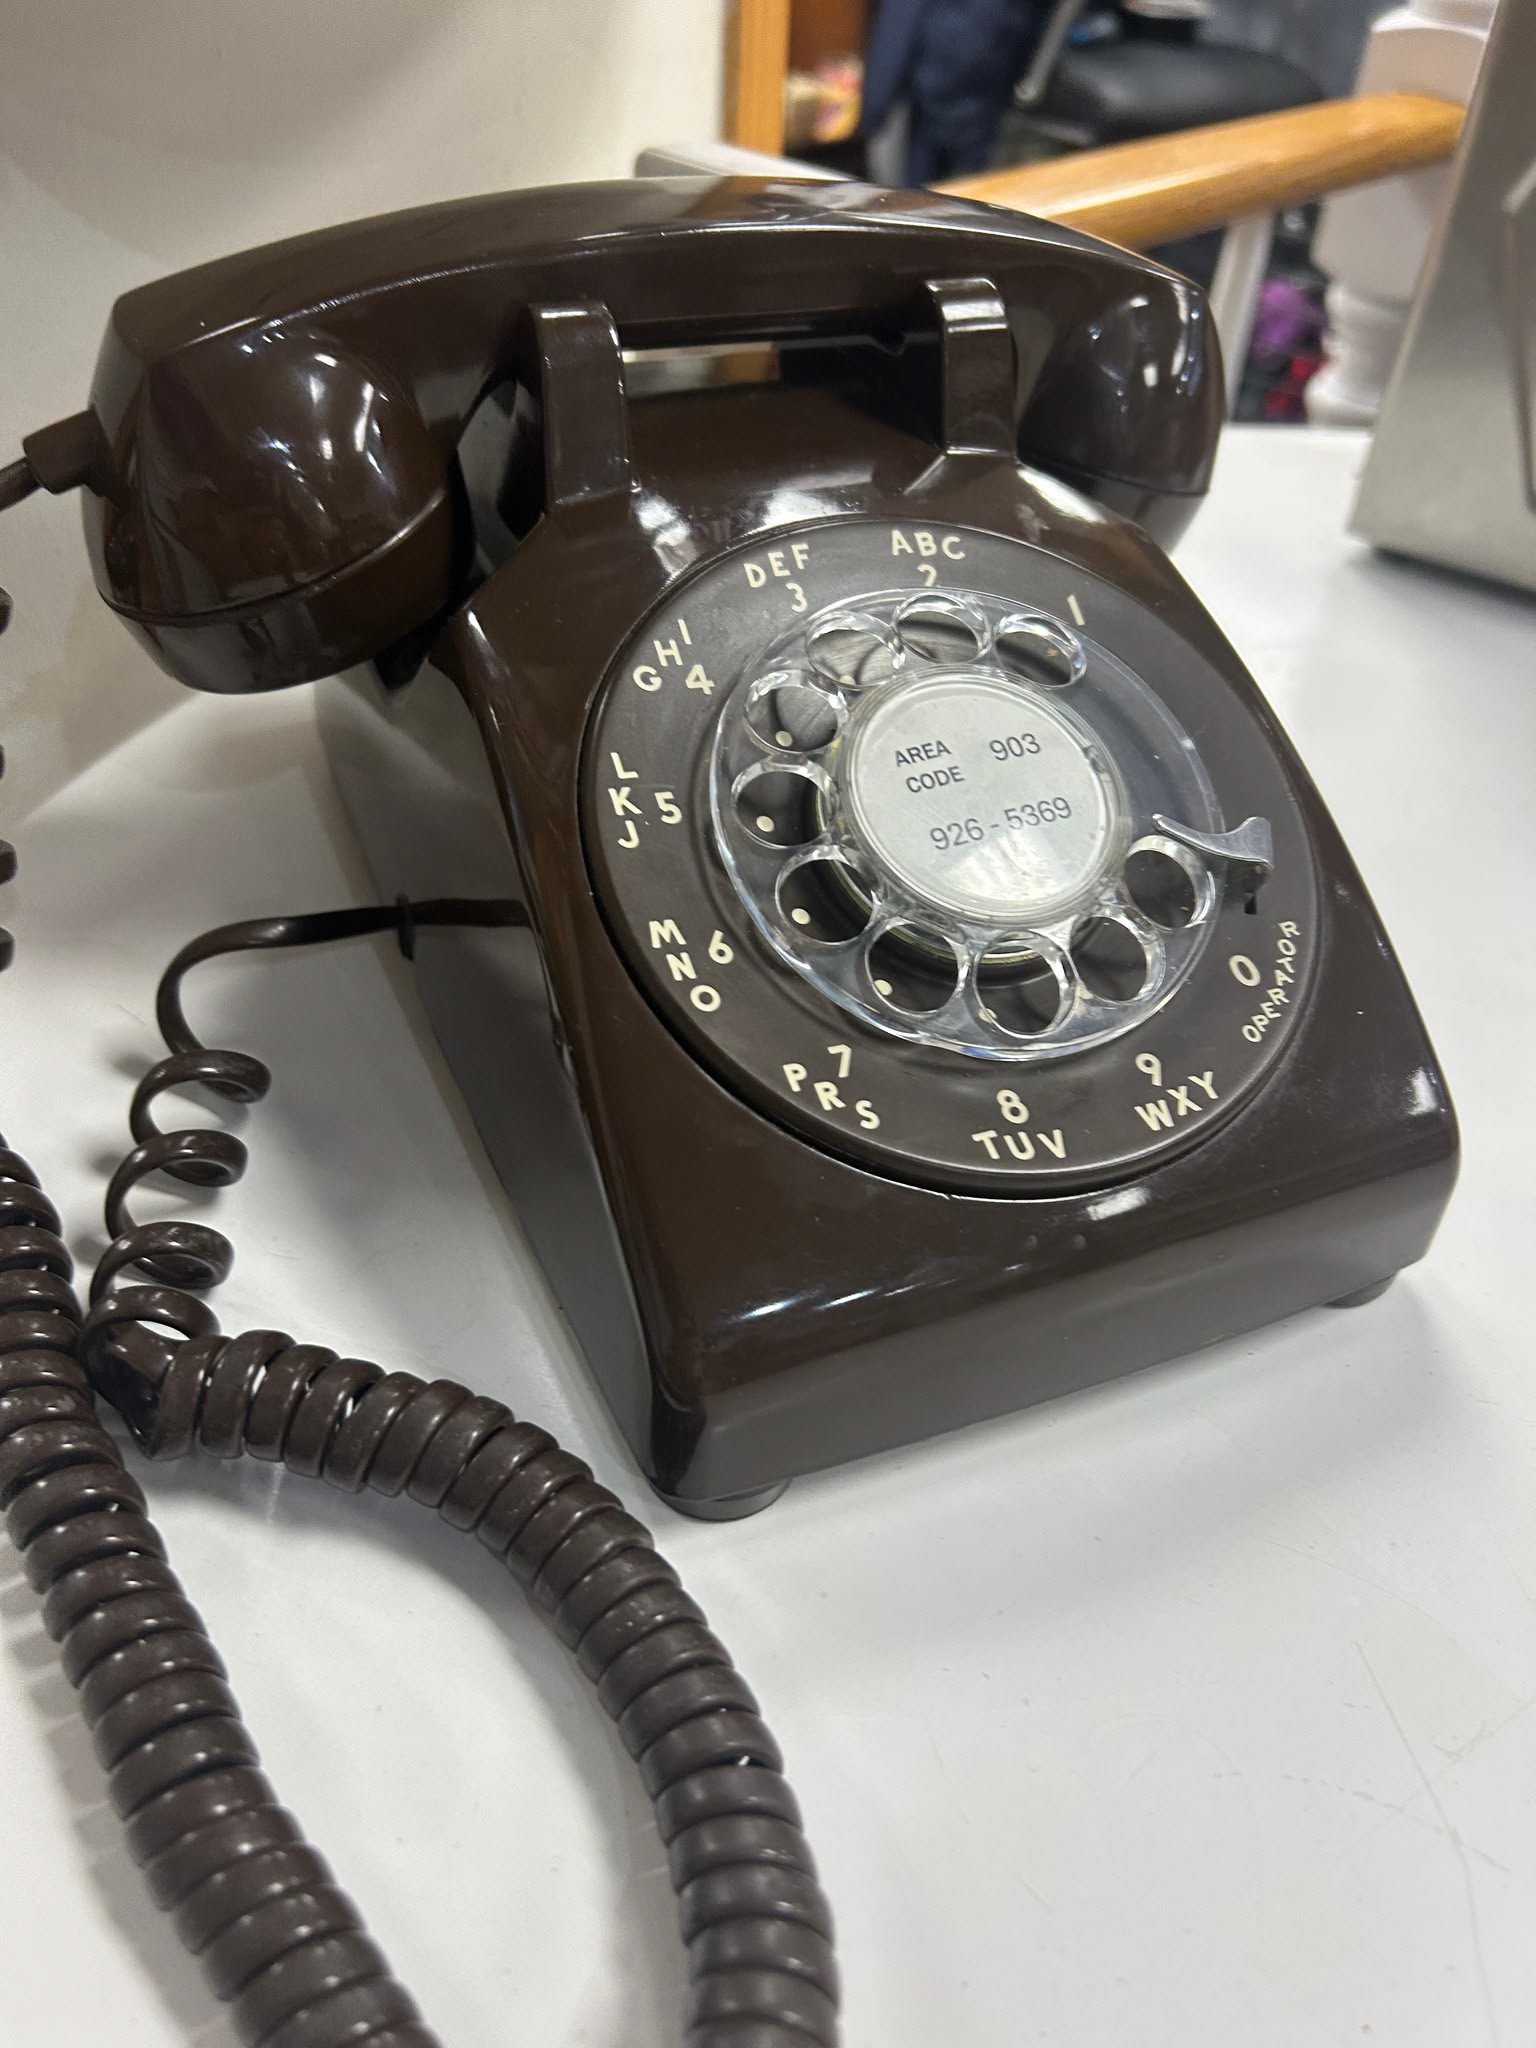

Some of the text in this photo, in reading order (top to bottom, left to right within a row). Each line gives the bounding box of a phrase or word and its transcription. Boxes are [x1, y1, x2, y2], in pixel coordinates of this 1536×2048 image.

[892, 530, 965, 560] ABC
[744, 544, 809, 588] DEF
[917, 564, 937, 587] 2
[786, 583, 808, 612] 3
[685, 664, 715, 695] 4
[895, 733, 1041, 767] AREA 903
[906, 766, 965, 793] CODE
[655, 791, 682, 824] 5
[708, 930, 734, 964] 6
[1241, 921, 1301, 1043] OPERATOR
[827, 1044, 851, 1078] 7
[1135, 1053, 1162, 1086] 9
[996, 1090, 1029, 1124] 8
[1134, 1071, 1218, 1131] WXY
[972, 1129, 1066, 1160] TUV
